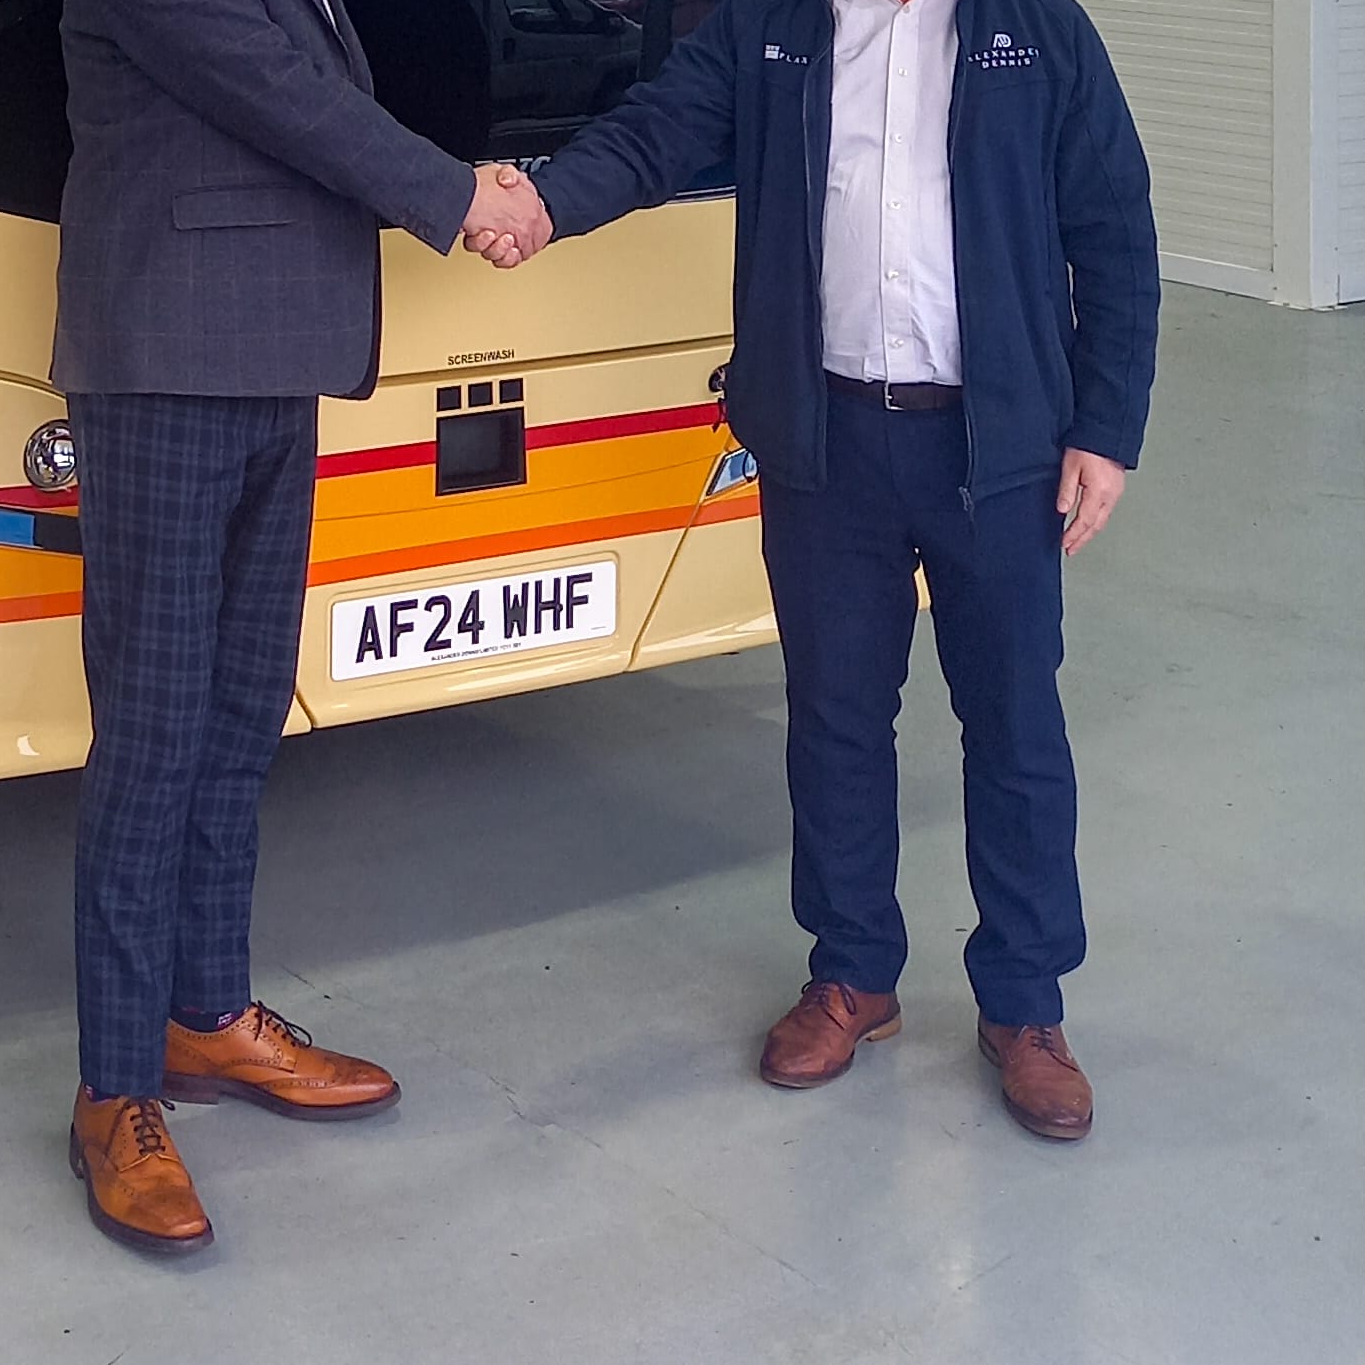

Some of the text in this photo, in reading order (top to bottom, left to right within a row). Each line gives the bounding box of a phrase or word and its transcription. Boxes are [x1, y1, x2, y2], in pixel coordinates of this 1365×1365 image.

[981, 57, 1032, 70] DENNIS
[447, 348, 515, 366] SCREENWASH
[355, 572, 593, 664] AF24 WHF
